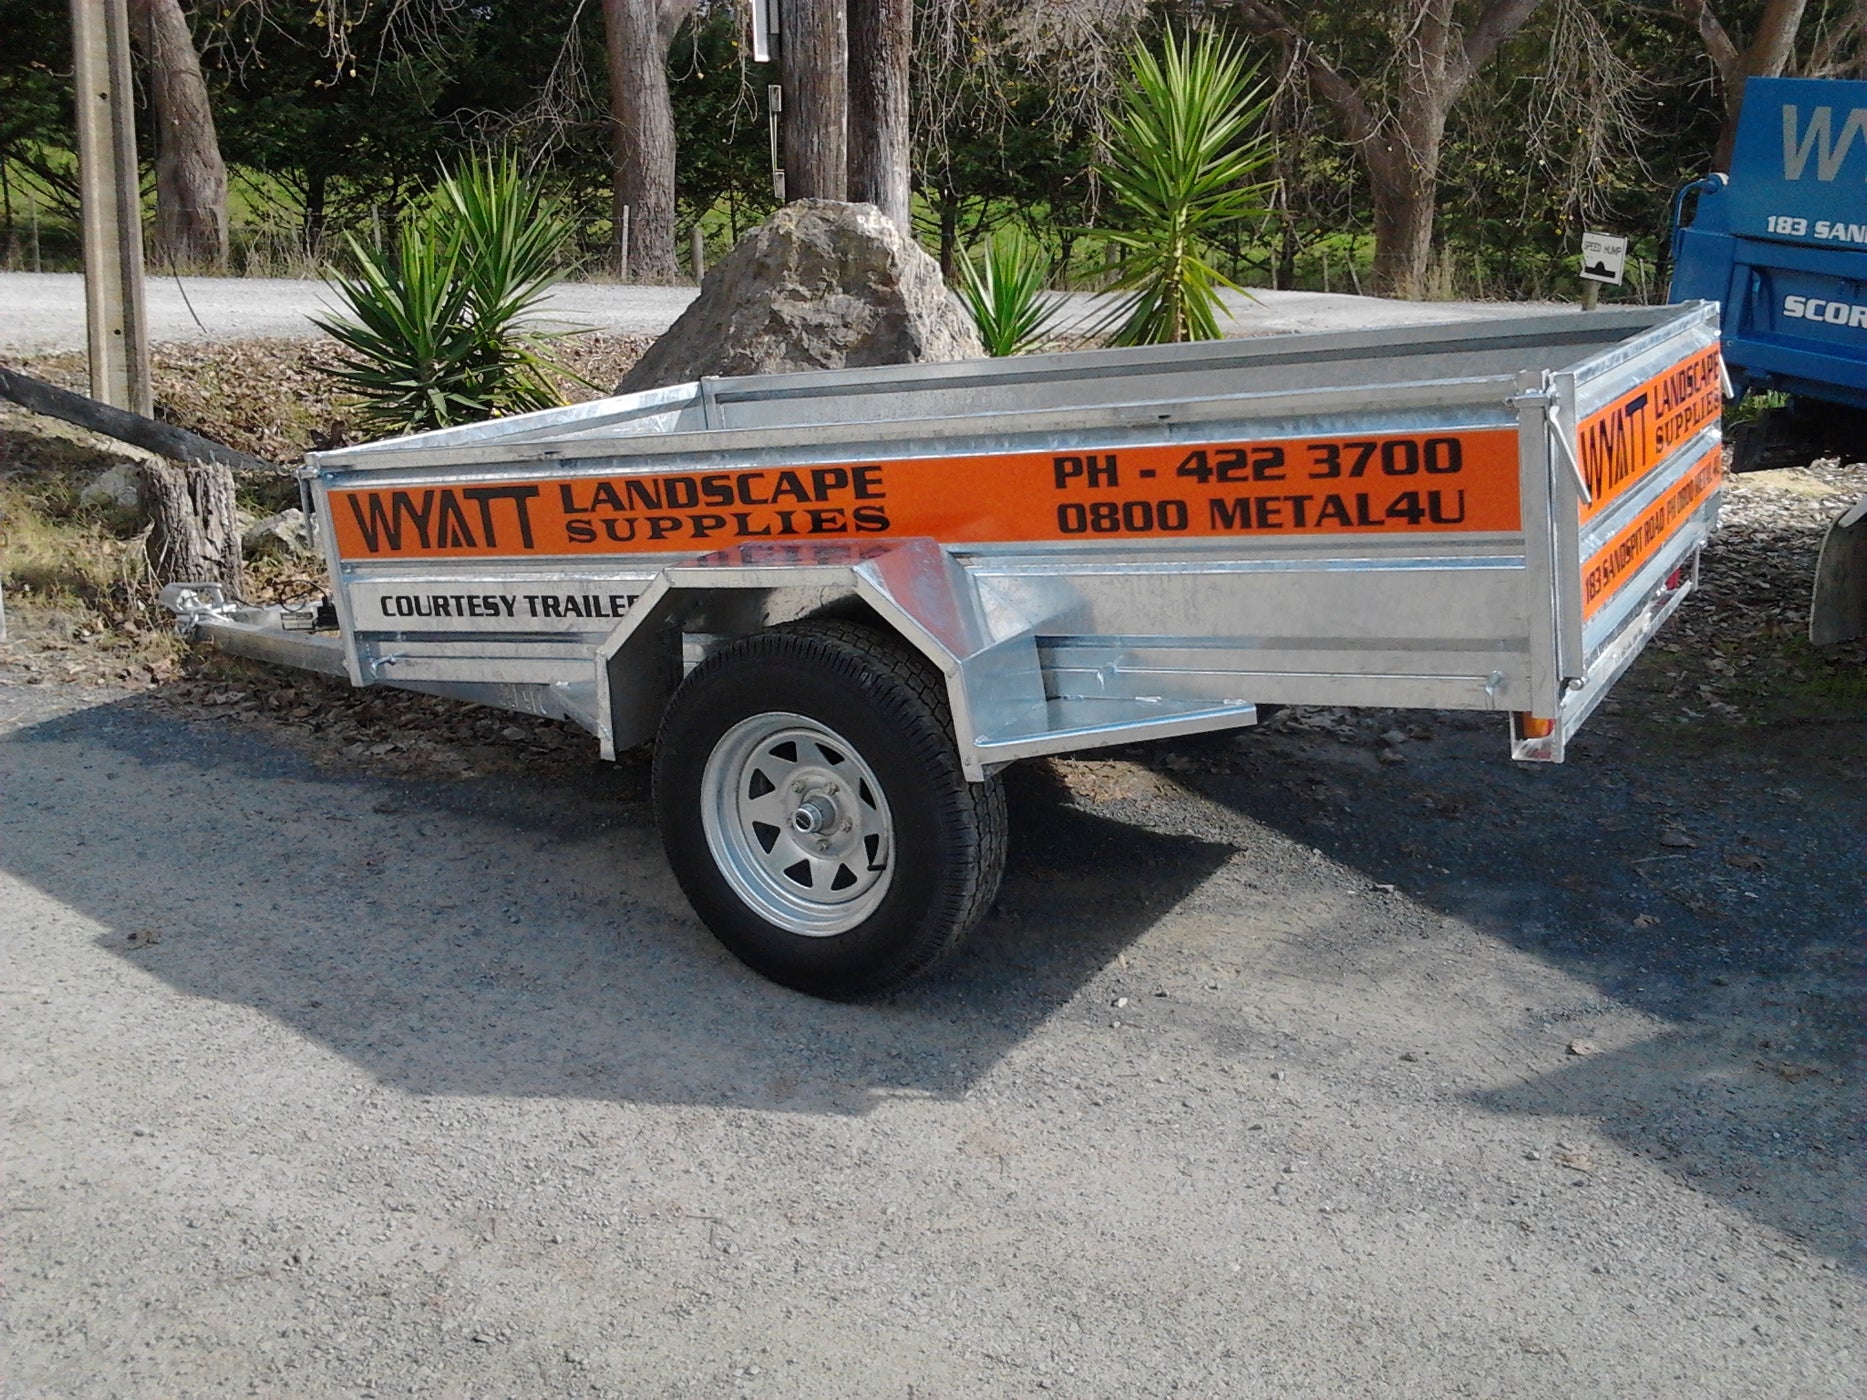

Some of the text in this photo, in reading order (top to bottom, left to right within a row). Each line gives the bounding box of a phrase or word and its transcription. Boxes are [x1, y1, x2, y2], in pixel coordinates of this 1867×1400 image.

[1782, 104, 1867, 182] W
[1767, 215, 1867, 243] 183 SAN
[1654, 349, 1719, 421] LANDSCAPE
[1655, 386, 1720, 455] SUPPLIES
[1053, 456, 1119, 489] PH
[1176, 447, 1287, 484] 422
[1307, 438, 1463, 480] 3700
[1580, 392, 1648, 511] WYATT
[347, 485, 540, 553] WYATT
[559, 465, 887, 515] LANDSCAPE
[1057, 490, 1465, 533] 0800 METAL4U
[565, 506, 891, 544] SUPPLIES
[1585, 566, 1601, 605] 183
[1602, 526, 1643, 588] SANDSPIT
[1644, 505, 1665, 548] ROAD
[380, 595, 517, 617] COURTESY
